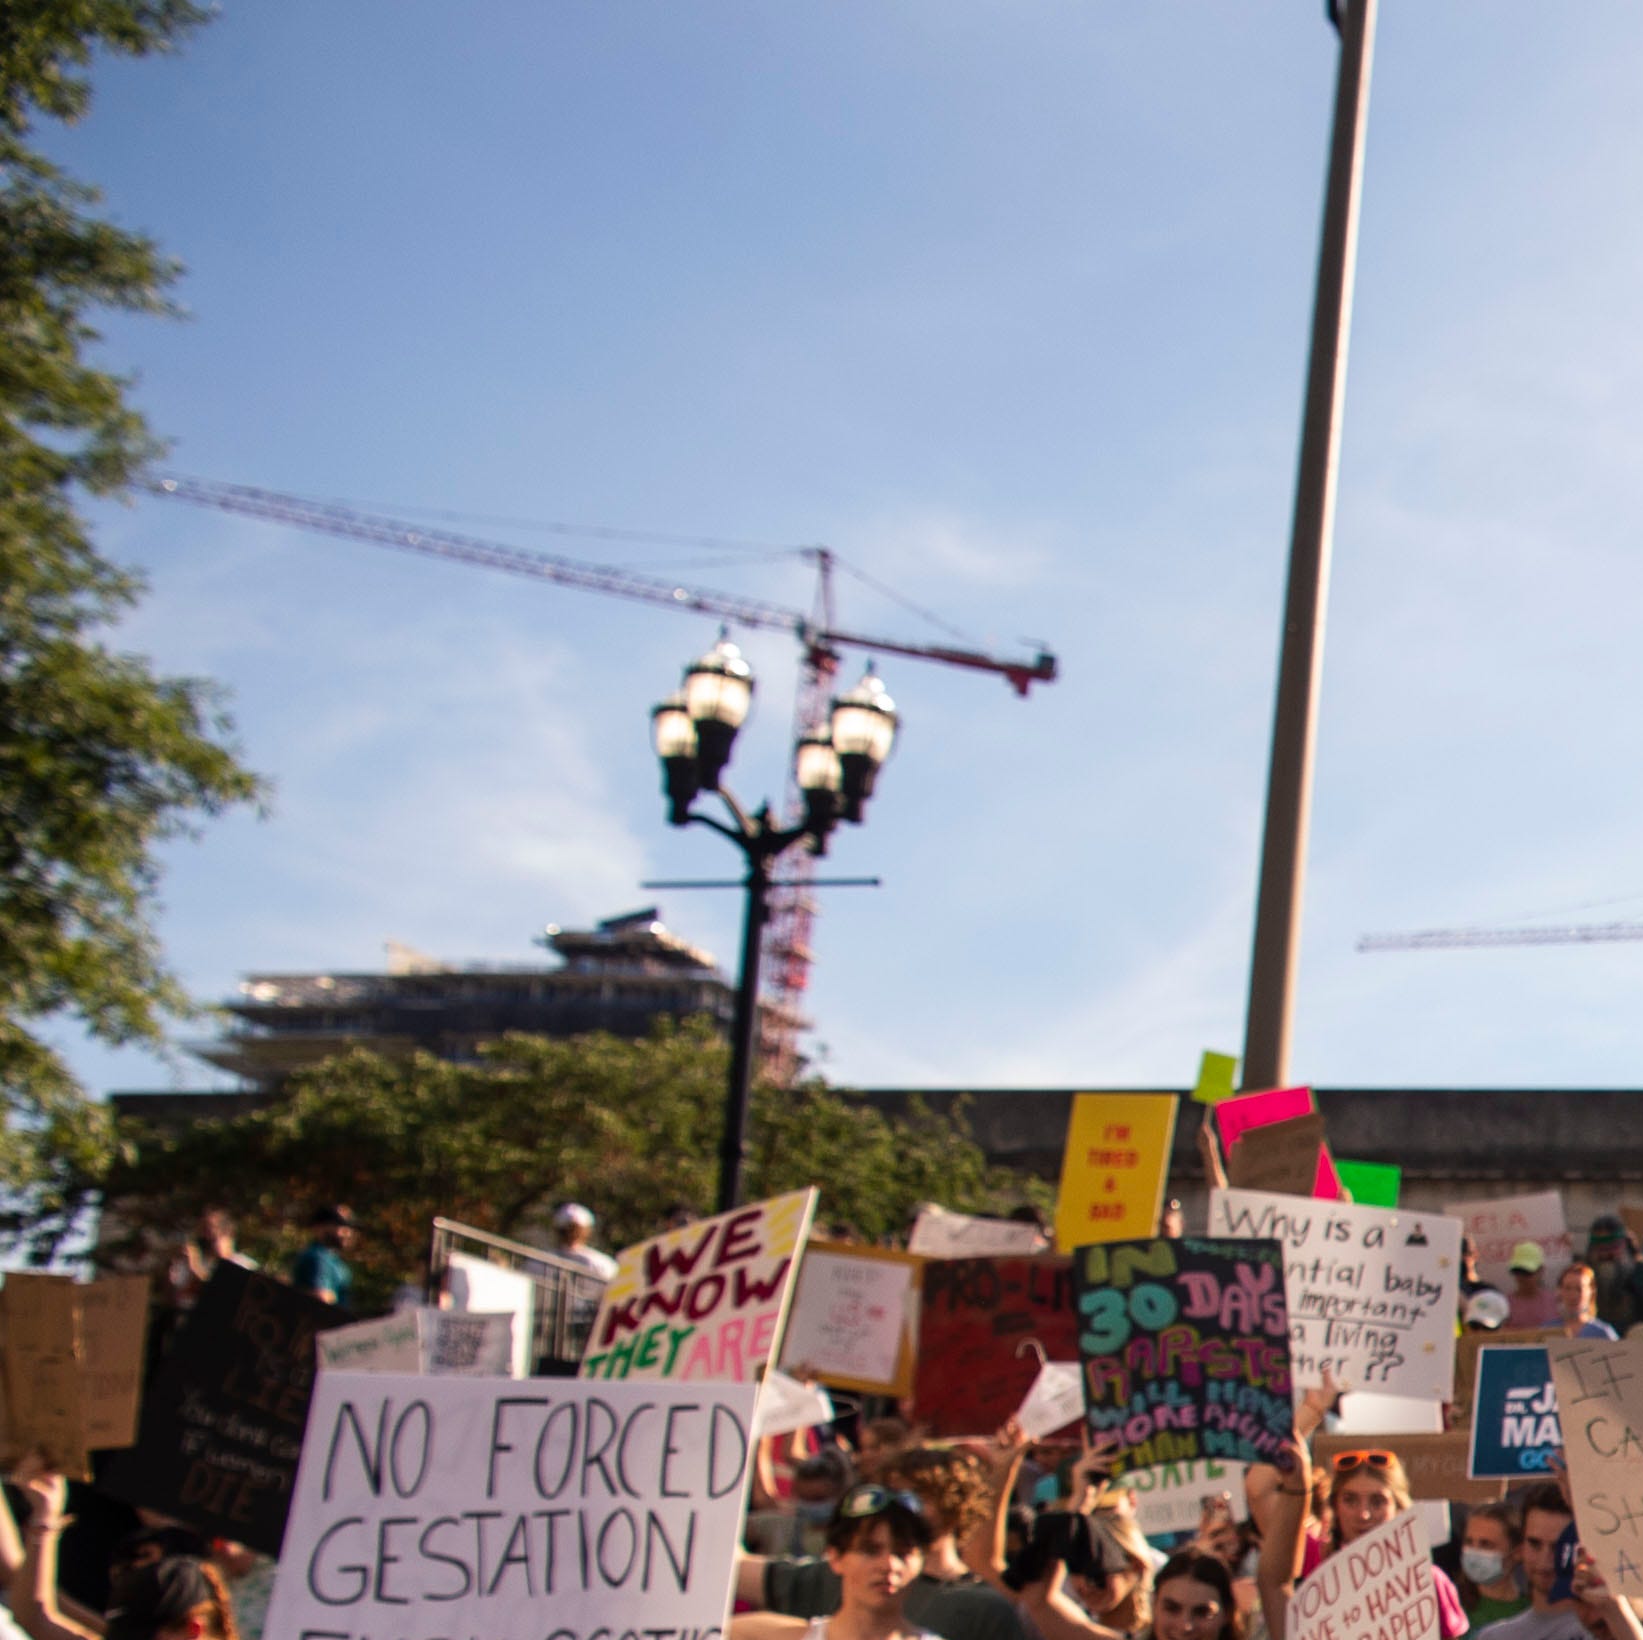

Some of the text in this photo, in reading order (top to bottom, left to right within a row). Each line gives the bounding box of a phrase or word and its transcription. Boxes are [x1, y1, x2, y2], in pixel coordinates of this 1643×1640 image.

[643, 1208, 765, 1288] WE
[1222, 1196, 1386, 1249] Why is a
[1085, 1240, 1178, 1289] IN
[1385, 1264, 1444, 1306] baby
[600, 1257, 793, 1349] KNOW
[1079, 1262, 1289, 1355] 30 DAYS
[1300, 1289, 1428, 1325] important
[584, 1321, 697, 1379] THEY
[681, 1311, 780, 1383] ARE
[1086, 1323, 1293, 1407] RAPISTS
[1323, 1318, 1398, 1358] living
[1555, 1348, 1636, 1404] IF
[321, 1396, 433, 1502] NO
[487, 1397, 748, 1501] FORCED
[1092, 1403, 1198, 1447] MORE
[305, 1507, 697, 1607] GESTATION
[1615, 1549, 1643, 1584] A
[1293, 1563, 1342, 1632] YOU
[1343, 1605, 1362, 1629] to
[1366, 1557, 1432, 1623] HAVE
